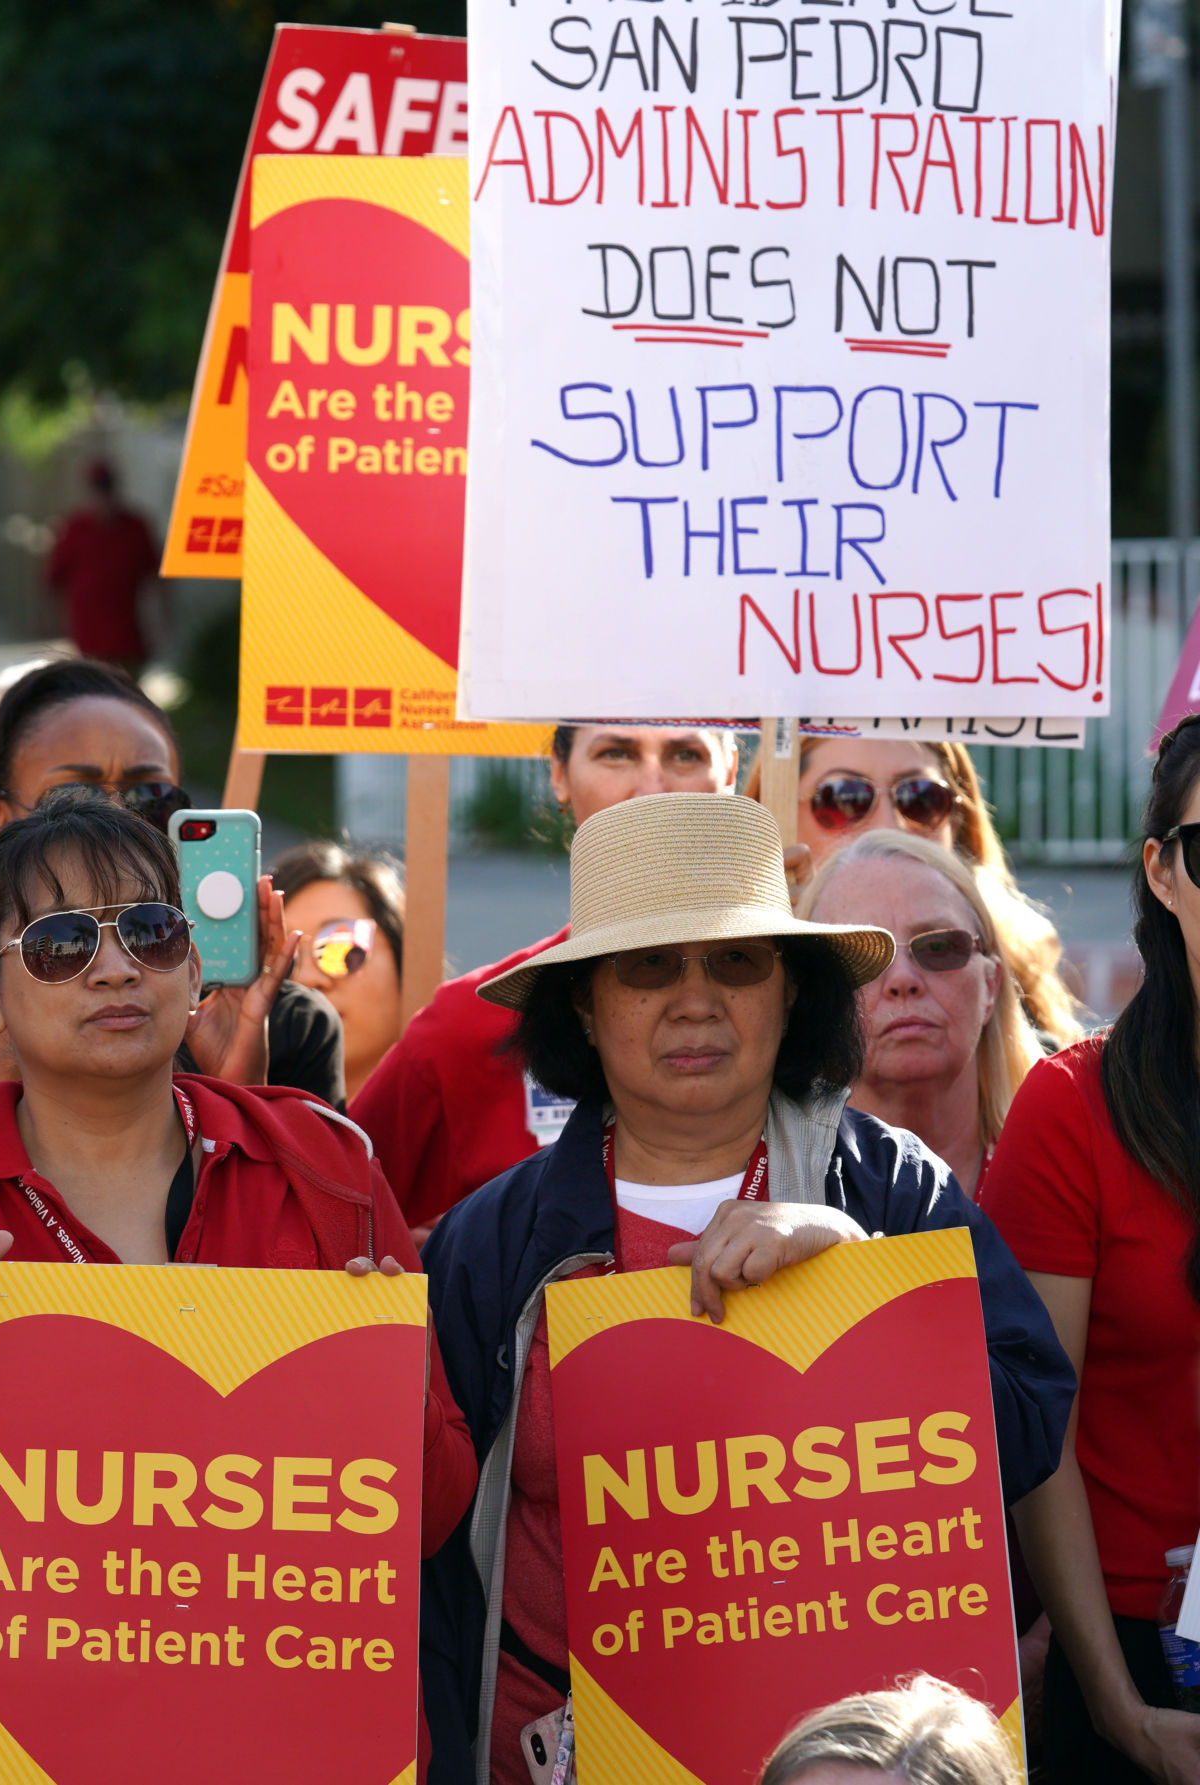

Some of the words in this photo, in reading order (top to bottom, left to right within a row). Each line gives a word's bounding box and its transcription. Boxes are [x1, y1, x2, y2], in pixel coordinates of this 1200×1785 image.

[532, 16, 698, 93] SAN
[728, 17, 983, 113] PEDRO
[269, 69, 468, 154] SAFE
[475, 106, 1103, 236] ADMINISTRATION
[582, 244, 795, 329] DOES
[835, 254, 996, 338] NOT
[267, 380, 357, 421] Are
[372, 381, 455, 423] the
[531, 383, 1039, 501] SUPPORT
[266, 435, 315, 472] of
[328, 437, 467, 475] Patien
[611, 496, 886, 585] THEIR
[739, 583, 1103, 703] NURSES!
[25, 1186, 49, 1220] Vision
[744, 1154, 768, 1200] lthcare.
[46, 1216, 58, 1228] A
[584, 1411, 976, 1525] NURSES
[103, 1548, 201, 1597] the
[227, 1554, 396, 1604] Heart
[589, 1547, 686, 1592] Are
[707, 1530, 800, 1577] the
[822, 1507, 983, 1565] Heart
[47, 1618, 245, 1666] Patient
[266, 1626, 394, 1671] Care
[593, 1610, 643, 1655] of
[663, 1591, 848, 1648] Patient
[867, 1584, 988, 1625] Care
